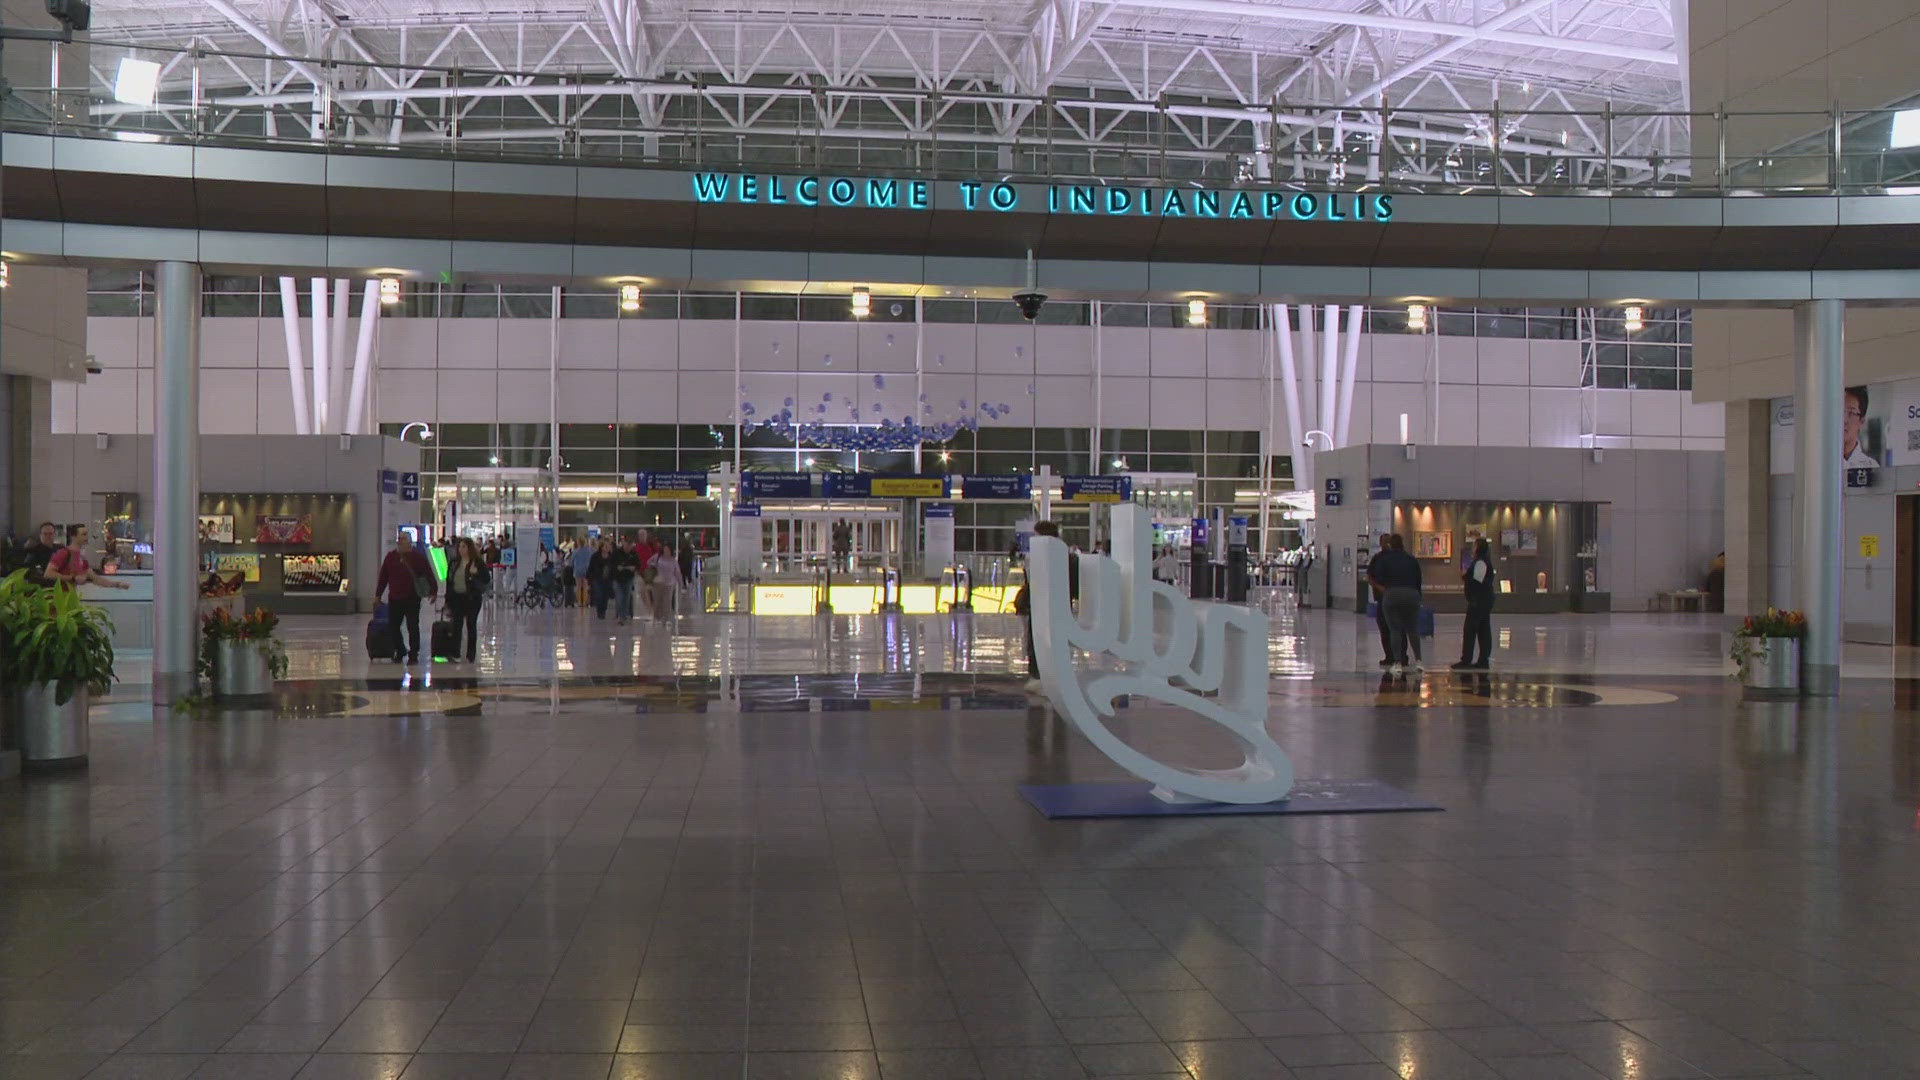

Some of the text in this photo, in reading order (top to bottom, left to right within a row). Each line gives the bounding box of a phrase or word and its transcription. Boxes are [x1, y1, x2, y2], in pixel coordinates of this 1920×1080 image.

[694, 172, 1394, 222] WELCOME TO INDIANAPOLIS
[1329, 480, 1336, 489] 5
